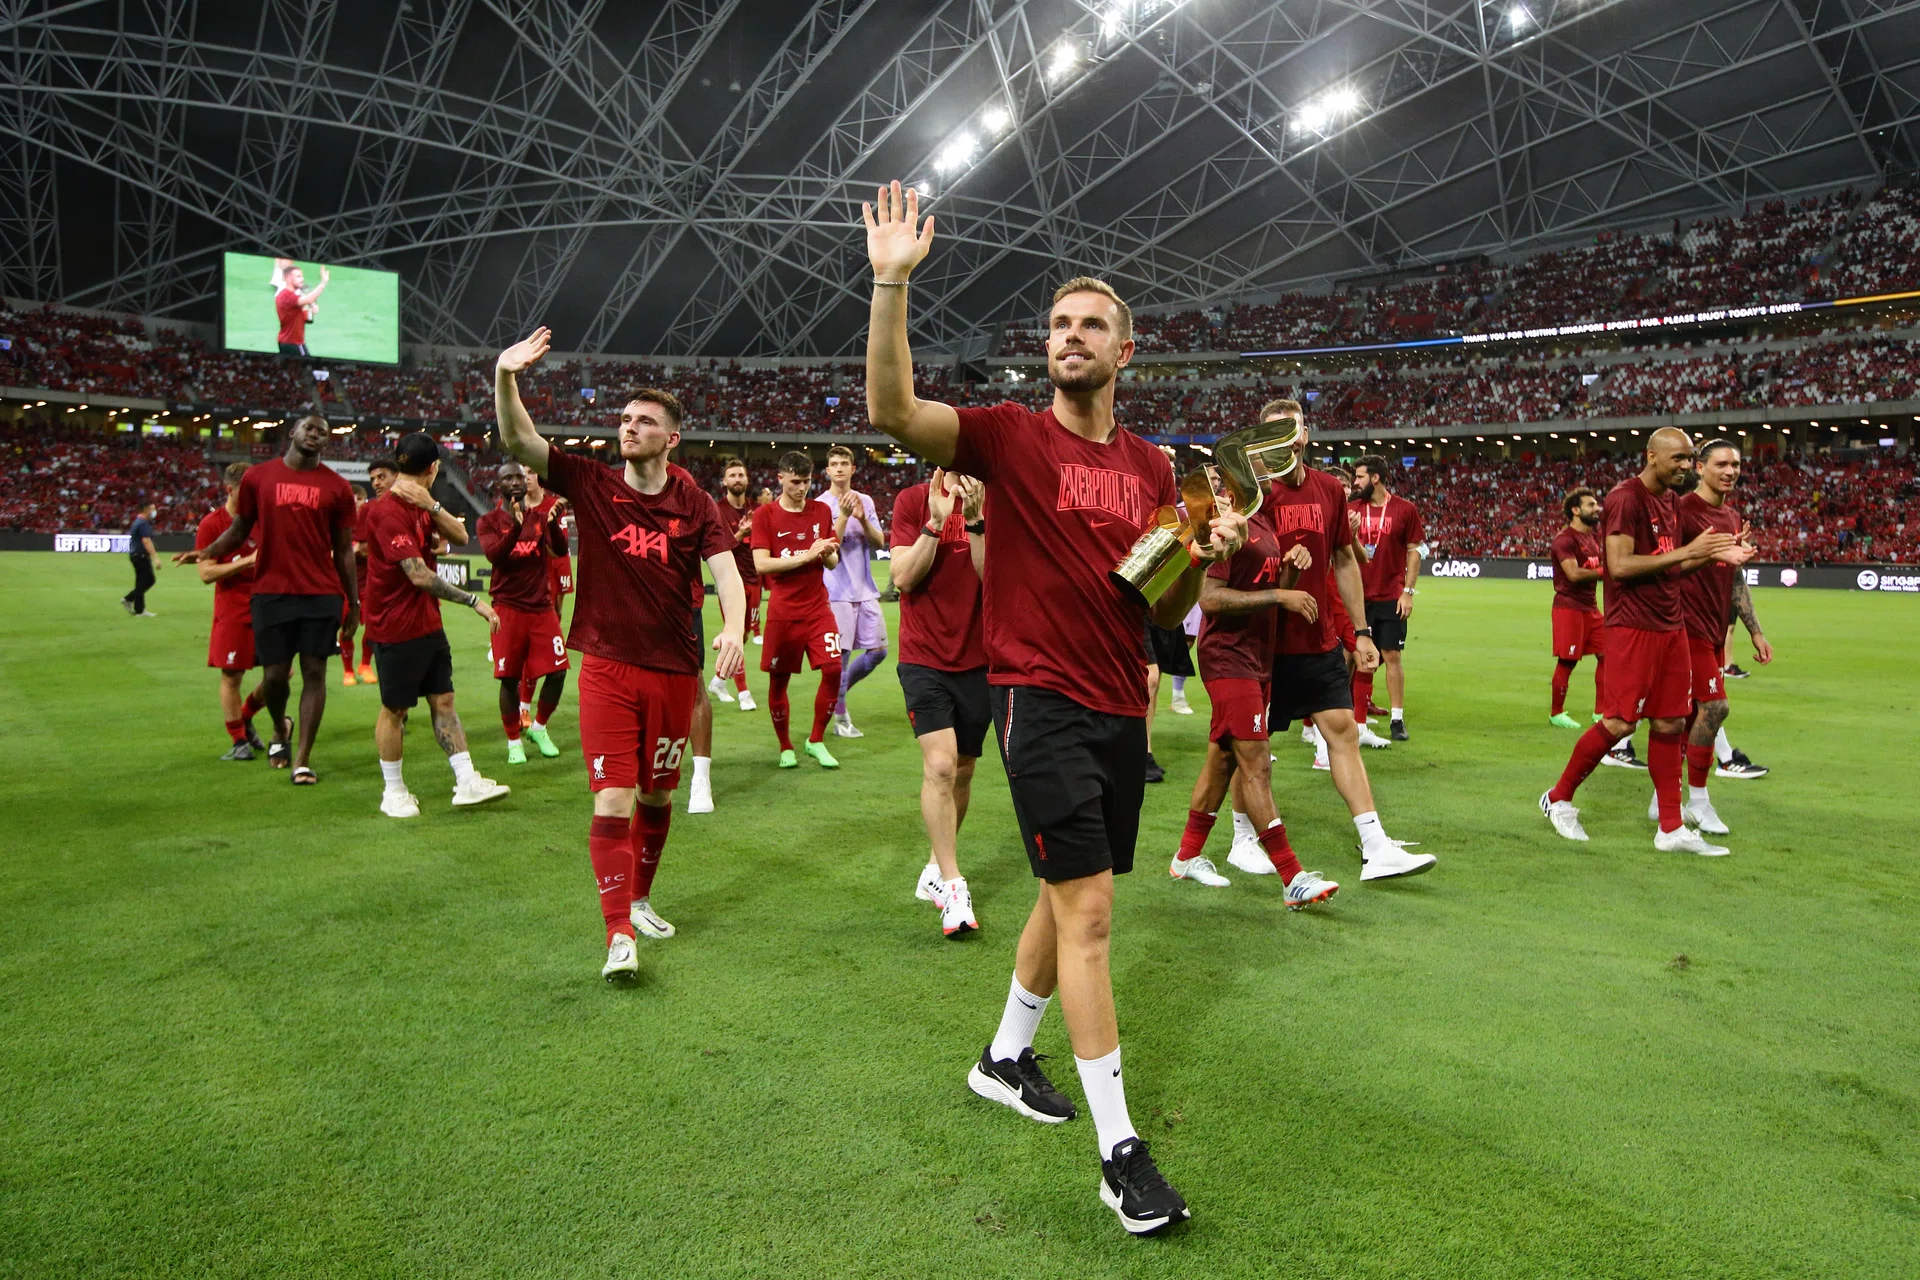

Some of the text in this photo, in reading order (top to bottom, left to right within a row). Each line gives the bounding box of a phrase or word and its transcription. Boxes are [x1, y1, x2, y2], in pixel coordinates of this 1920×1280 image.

[1462, 334, 1488, 344] THANK
[1489, 332, 1506, 341] YOU
[1507, 331, 1523, 339] FOR
[1525, 328, 1557, 338] VISITING
[1559, 323, 1604, 335] SINGAPORE
[1606, 320, 1638, 330] SPORTS
[1663, 314, 1695, 325] PLEASE
[1697, 311, 1726, 322] ENJOY
[1728, 307, 1767, 319] TODAY'S
[1769, 303, 1802, 315] EVENT.
[55, 537, 80, 552] LEFT
[81, 538, 111, 552] FIELD
[610, 523, 668, 564] AXA
[437, 563, 460, 585] PIONS
[1253, 557, 1280, 583] AX
[1432, 560, 1480, 577] CARRO
[552, 636, 565, 656] 8
[653, 737, 686, 769] 26
